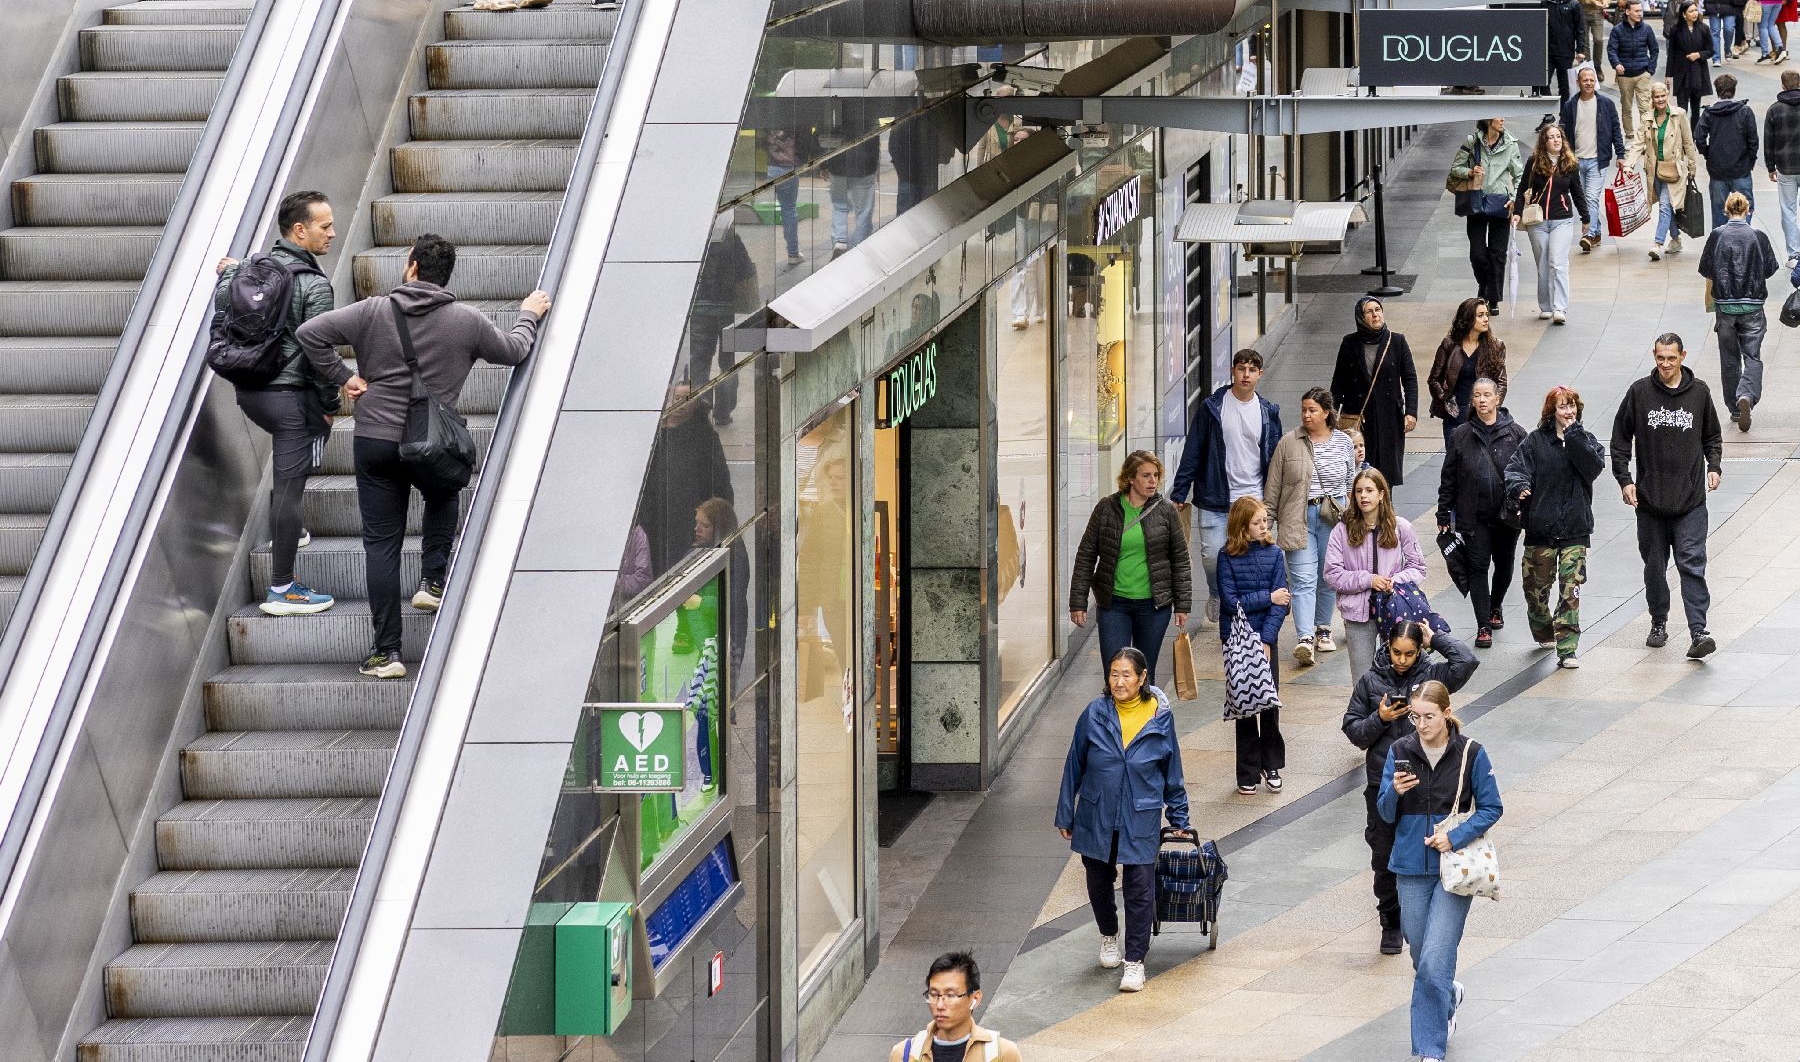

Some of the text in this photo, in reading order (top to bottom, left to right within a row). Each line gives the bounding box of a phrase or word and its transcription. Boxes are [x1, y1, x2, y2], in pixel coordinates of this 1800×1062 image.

[1382, 34, 1523, 63] DOUGLAS
[891, 342, 937, 429] DOUGLAS
[613, 754, 669, 772] AED
